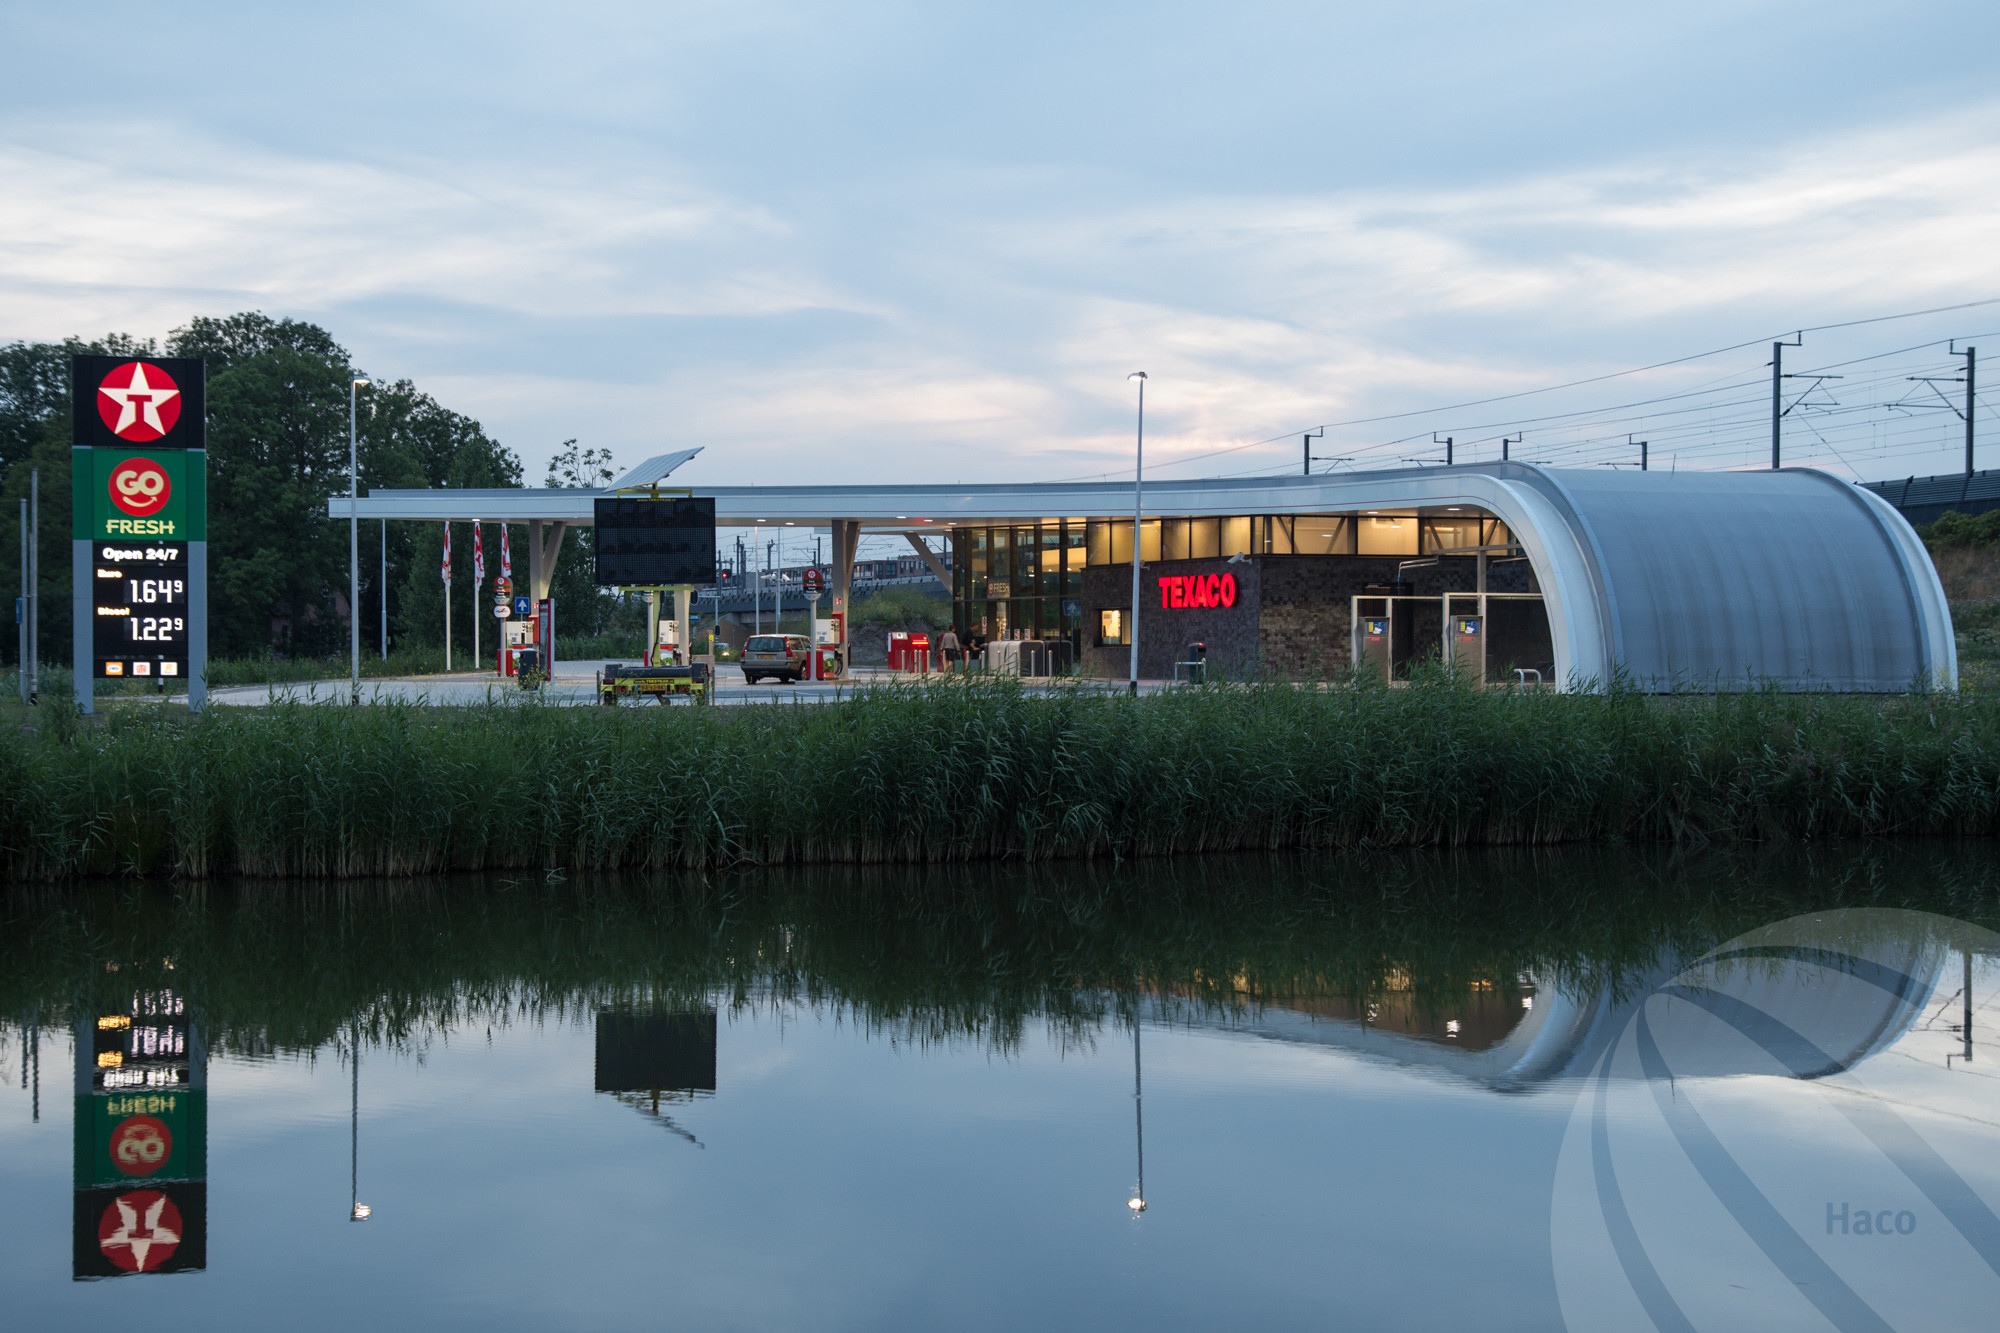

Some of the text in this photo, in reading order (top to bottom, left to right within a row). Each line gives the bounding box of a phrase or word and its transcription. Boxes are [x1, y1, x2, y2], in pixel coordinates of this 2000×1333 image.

[116, 470, 164, 496] GO
[106, 519, 175, 534] FRESH
[102, 547, 179, 562] Open 24/7
[1158, 572, 1236, 609] TEXACO
